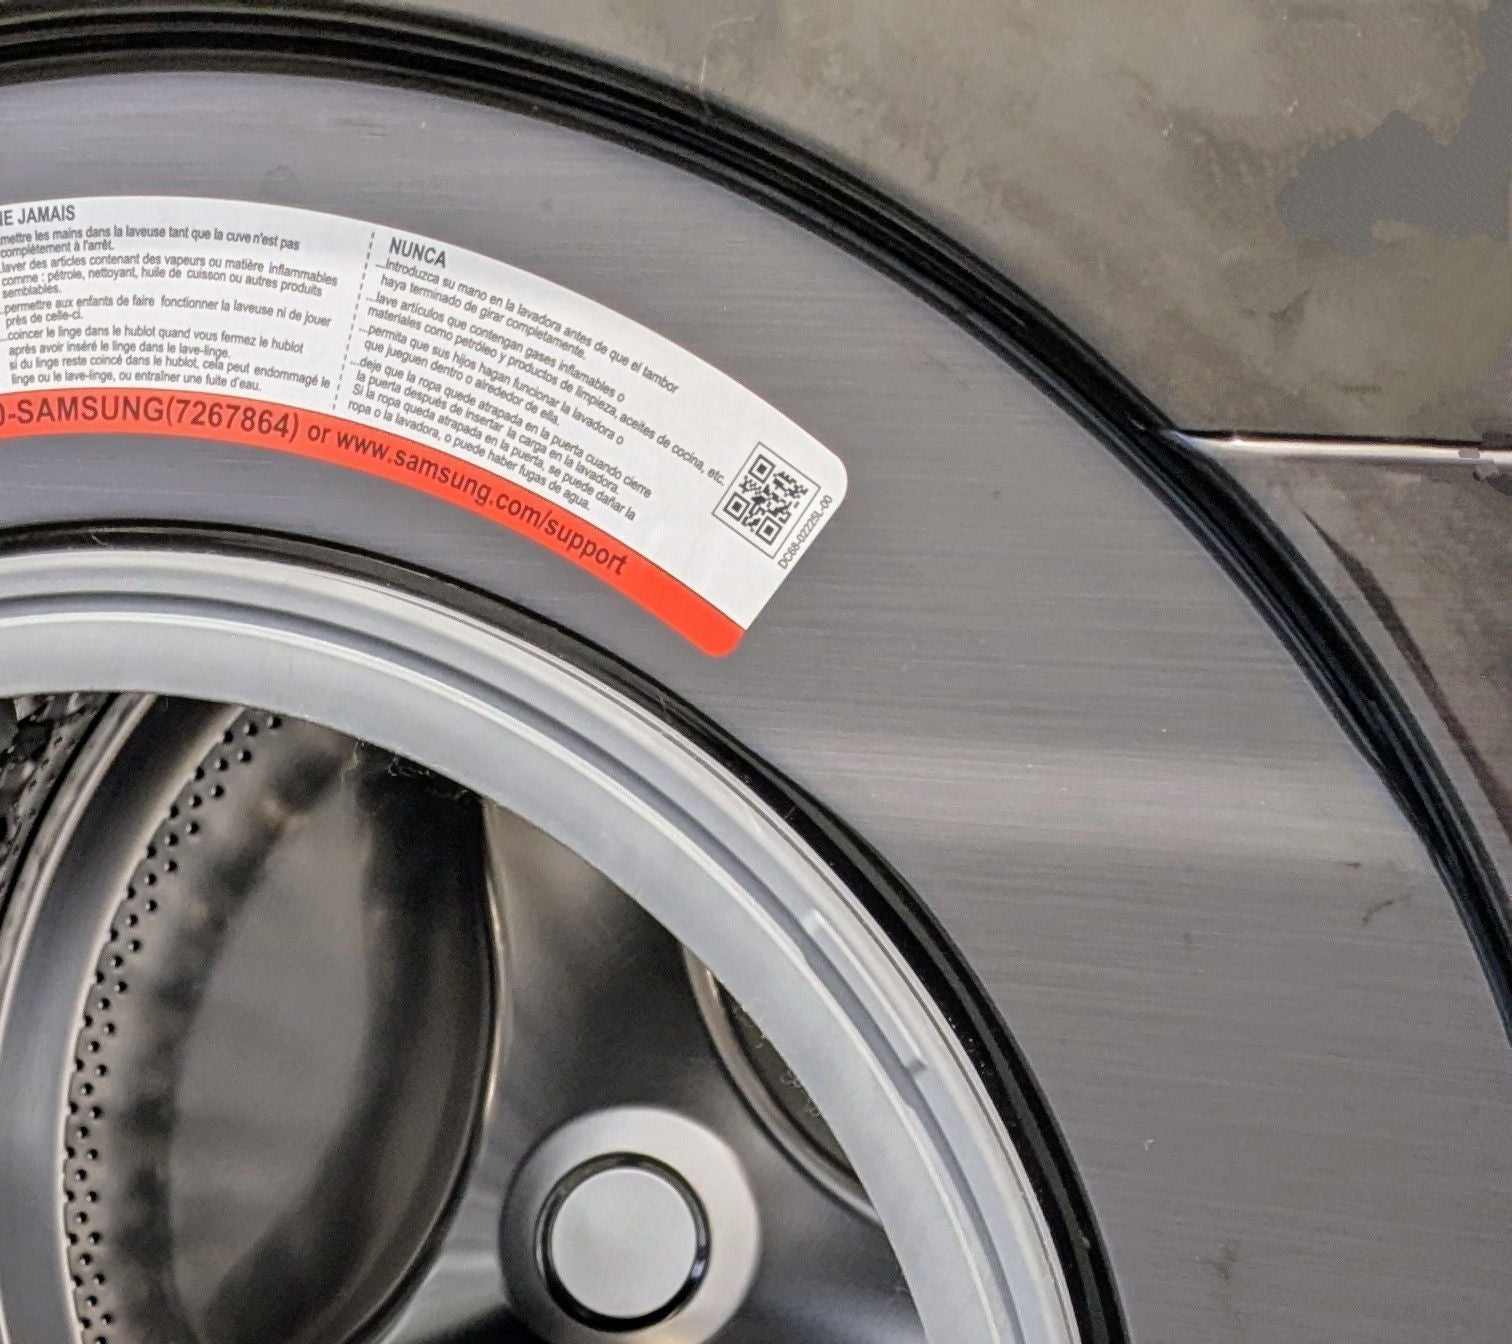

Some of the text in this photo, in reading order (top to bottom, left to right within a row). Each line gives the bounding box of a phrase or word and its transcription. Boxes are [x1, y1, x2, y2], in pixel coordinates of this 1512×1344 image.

[17, 204, 76, 225] JAMAIS
[35, 230, 49, 241] les
[53, 227, 83, 239] mains
[86, 226, 111, 238] dans
[114, 225, 123, 237] la
[125, 224, 166, 238] laveuse
[169, 226, 189, 239] tant
[191, 228, 212, 242] que
[214, 227, 223, 240] la
[226, 231, 251, 243] cuve
[280, 238, 300, 251] pas
[389, 236, 446, 269] NUNCA
[442, 277, 680, 394] su mano en la lavadora antes de que el tambor
[307, 423, 328, 444] or
[337, 429, 628, 575] www.samsung.com/support
